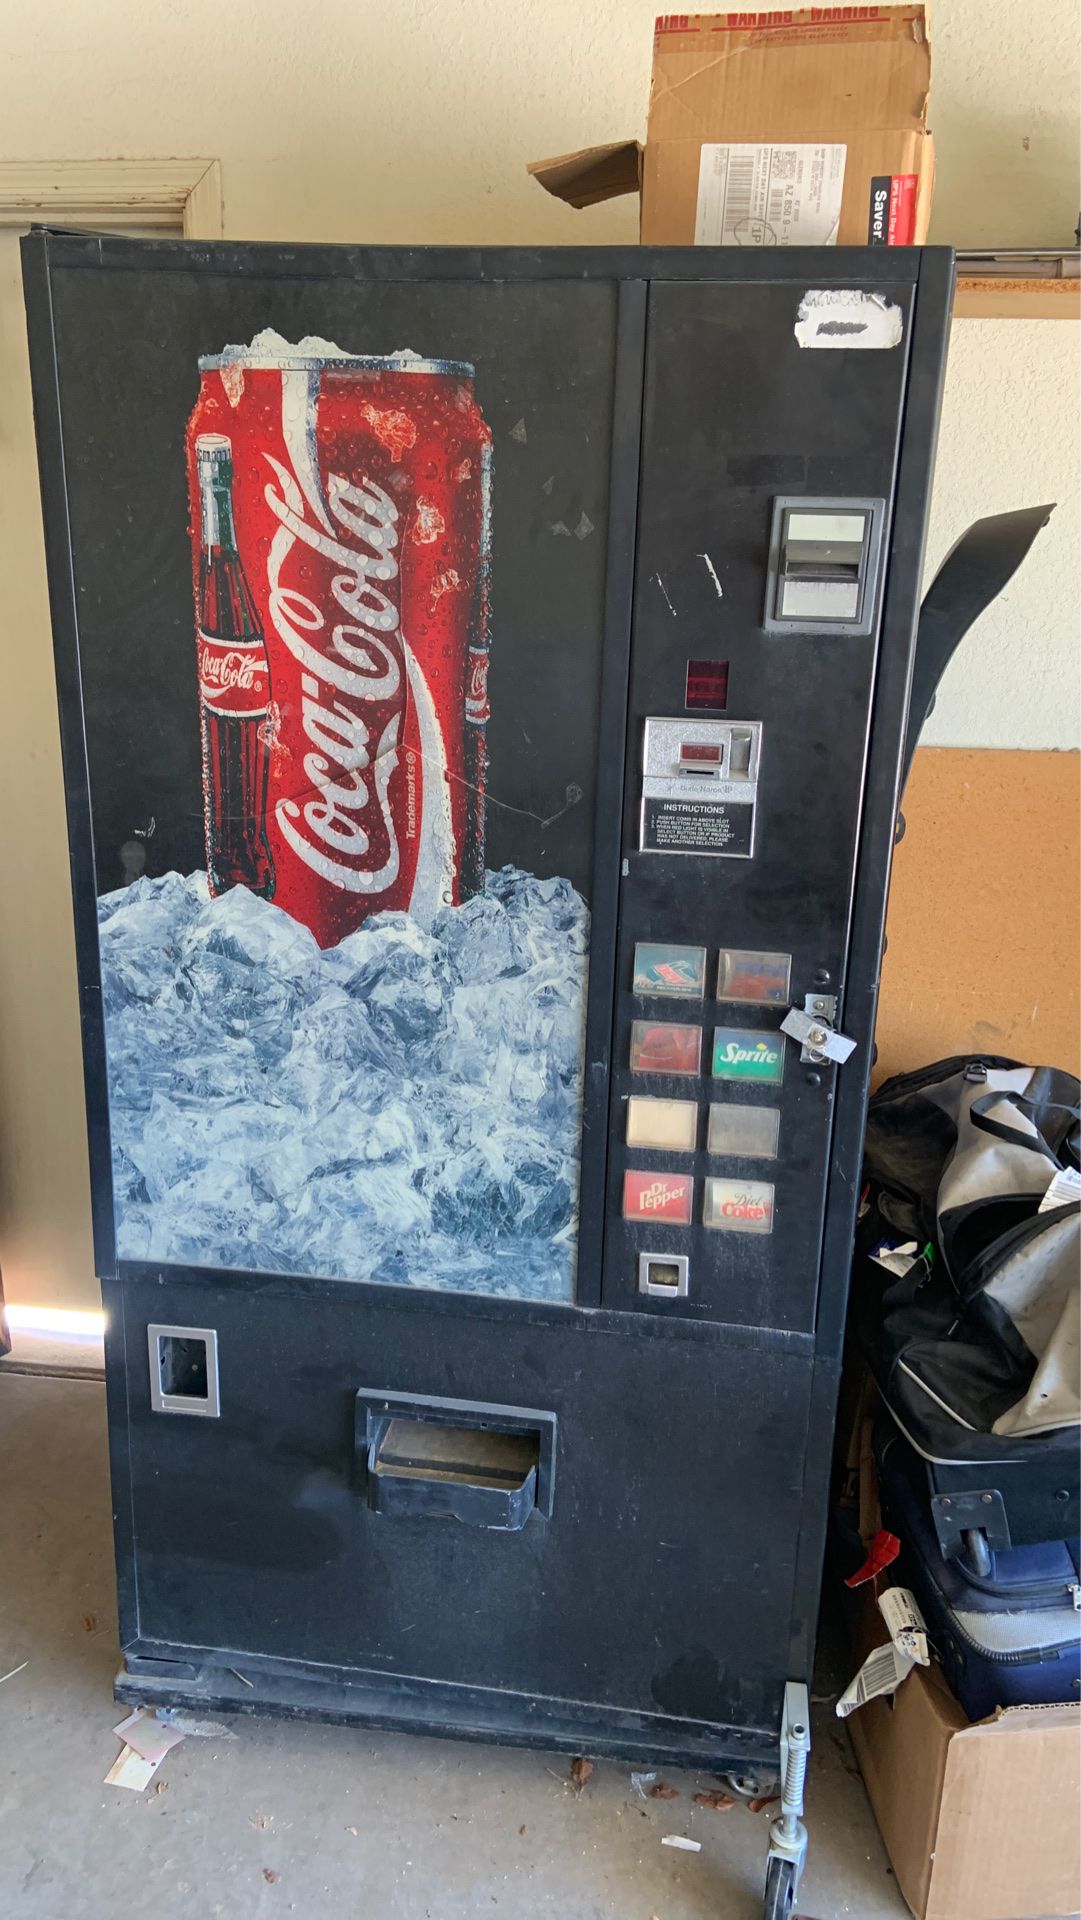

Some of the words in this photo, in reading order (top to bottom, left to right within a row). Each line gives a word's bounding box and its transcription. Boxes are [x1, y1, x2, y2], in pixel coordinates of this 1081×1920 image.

[873, 190, 887, 239] Saver
[889, 217, 897, 232] Day
[663, 804, 725, 814] INSTRUCTIONS
[720, 1042, 778, 1064] Sprite
[651, 1182, 668, 1195] Dr
[639, 1187, 686, 1211] Pepper
[734, 1193, 762, 1206] Diet
